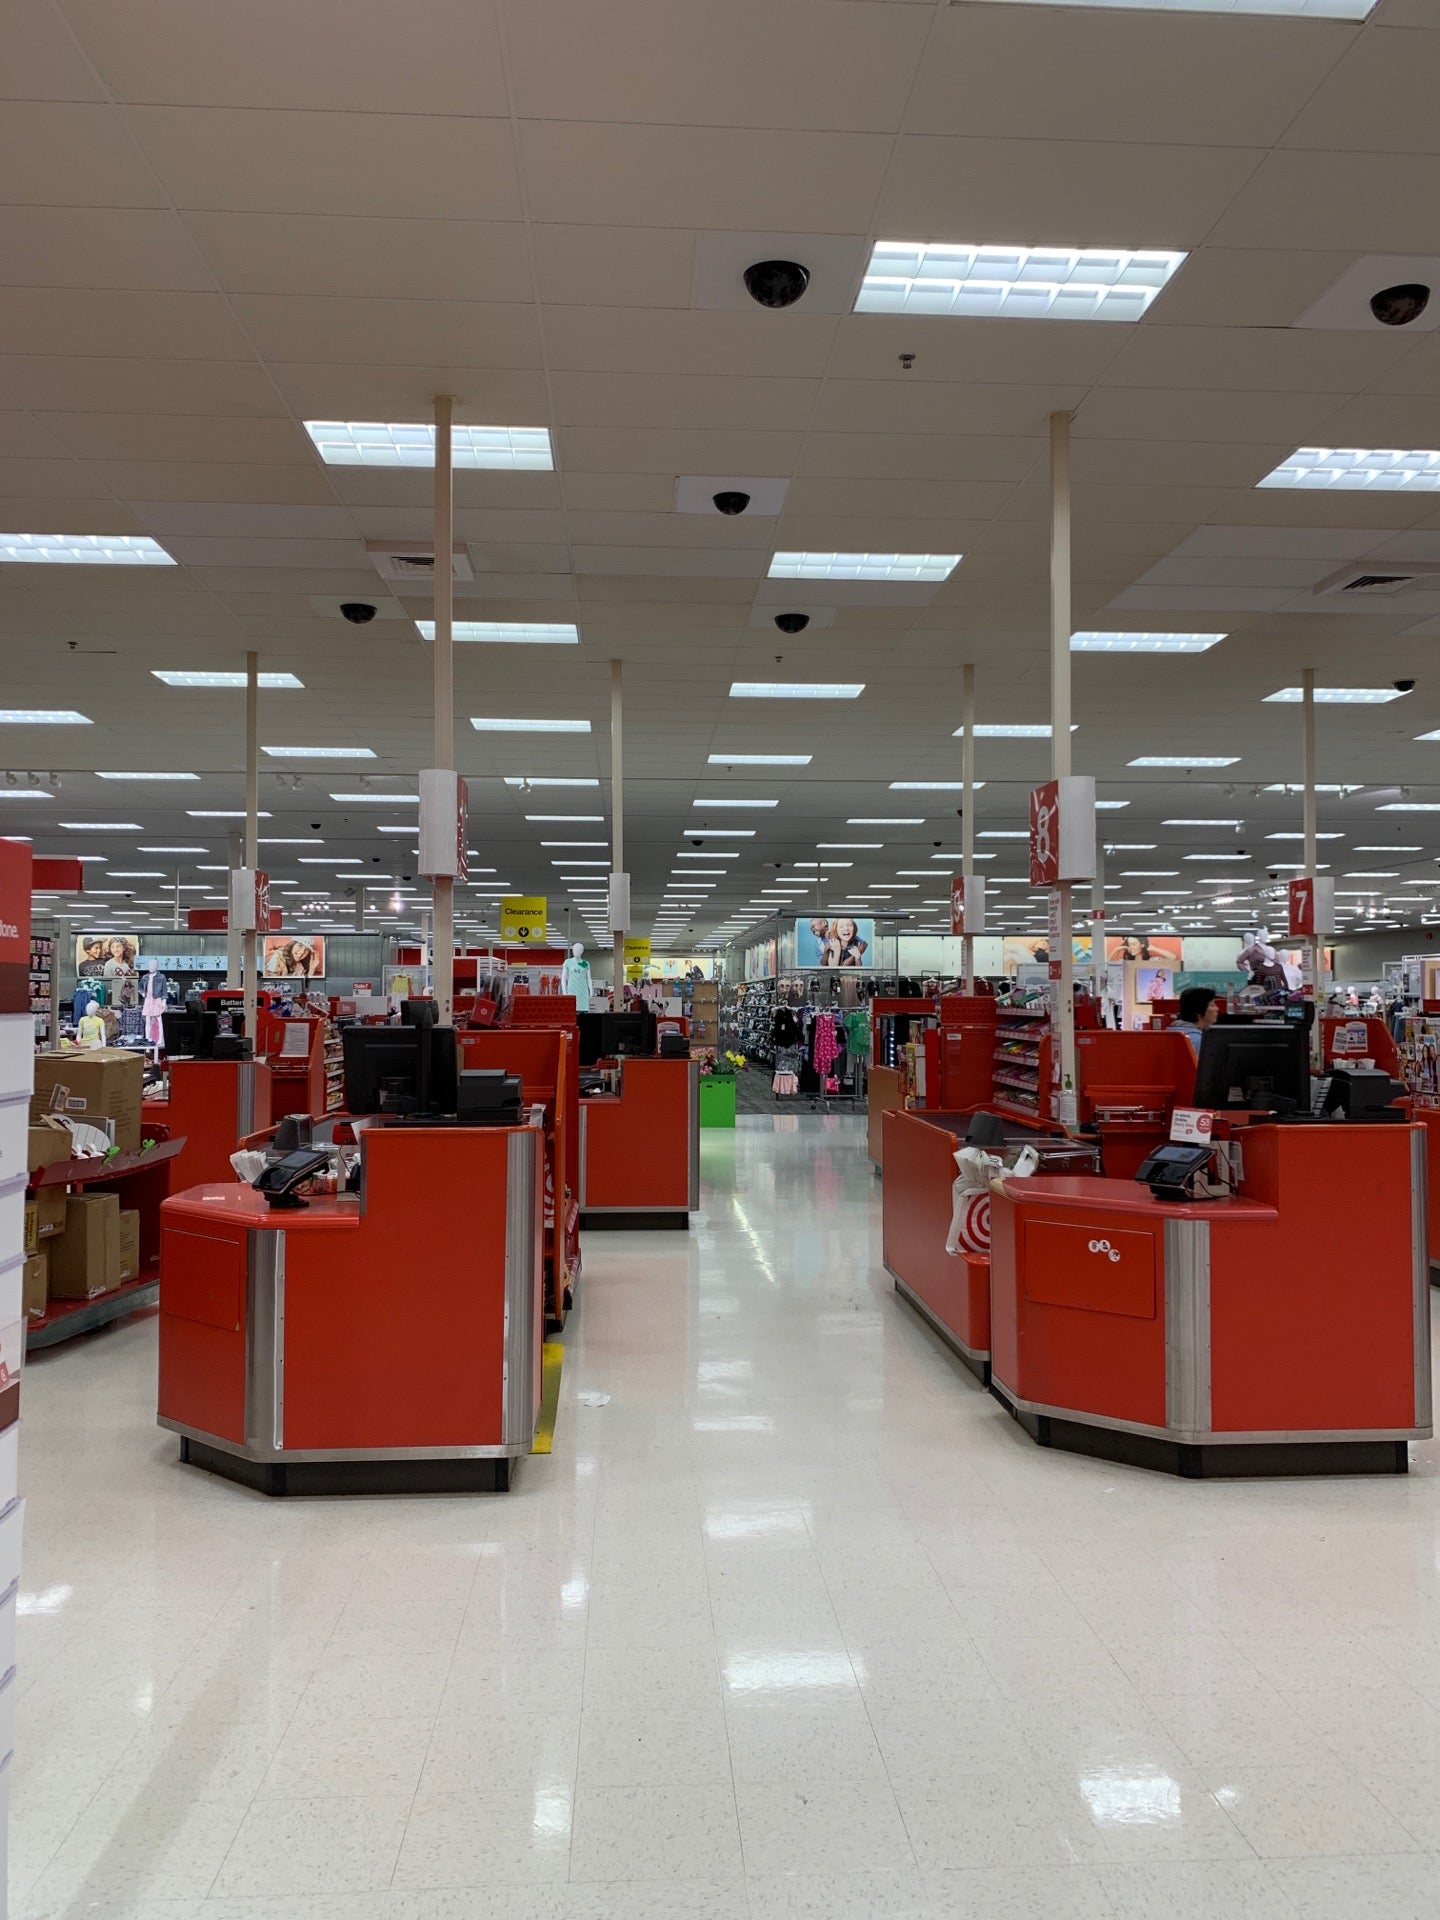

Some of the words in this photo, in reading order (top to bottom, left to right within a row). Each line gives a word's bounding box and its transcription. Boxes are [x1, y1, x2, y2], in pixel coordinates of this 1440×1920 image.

[1037, 805, 1050, 863] 8
[505, 908, 543, 916] Clearance
[1295, 890, 1308, 923] 7
